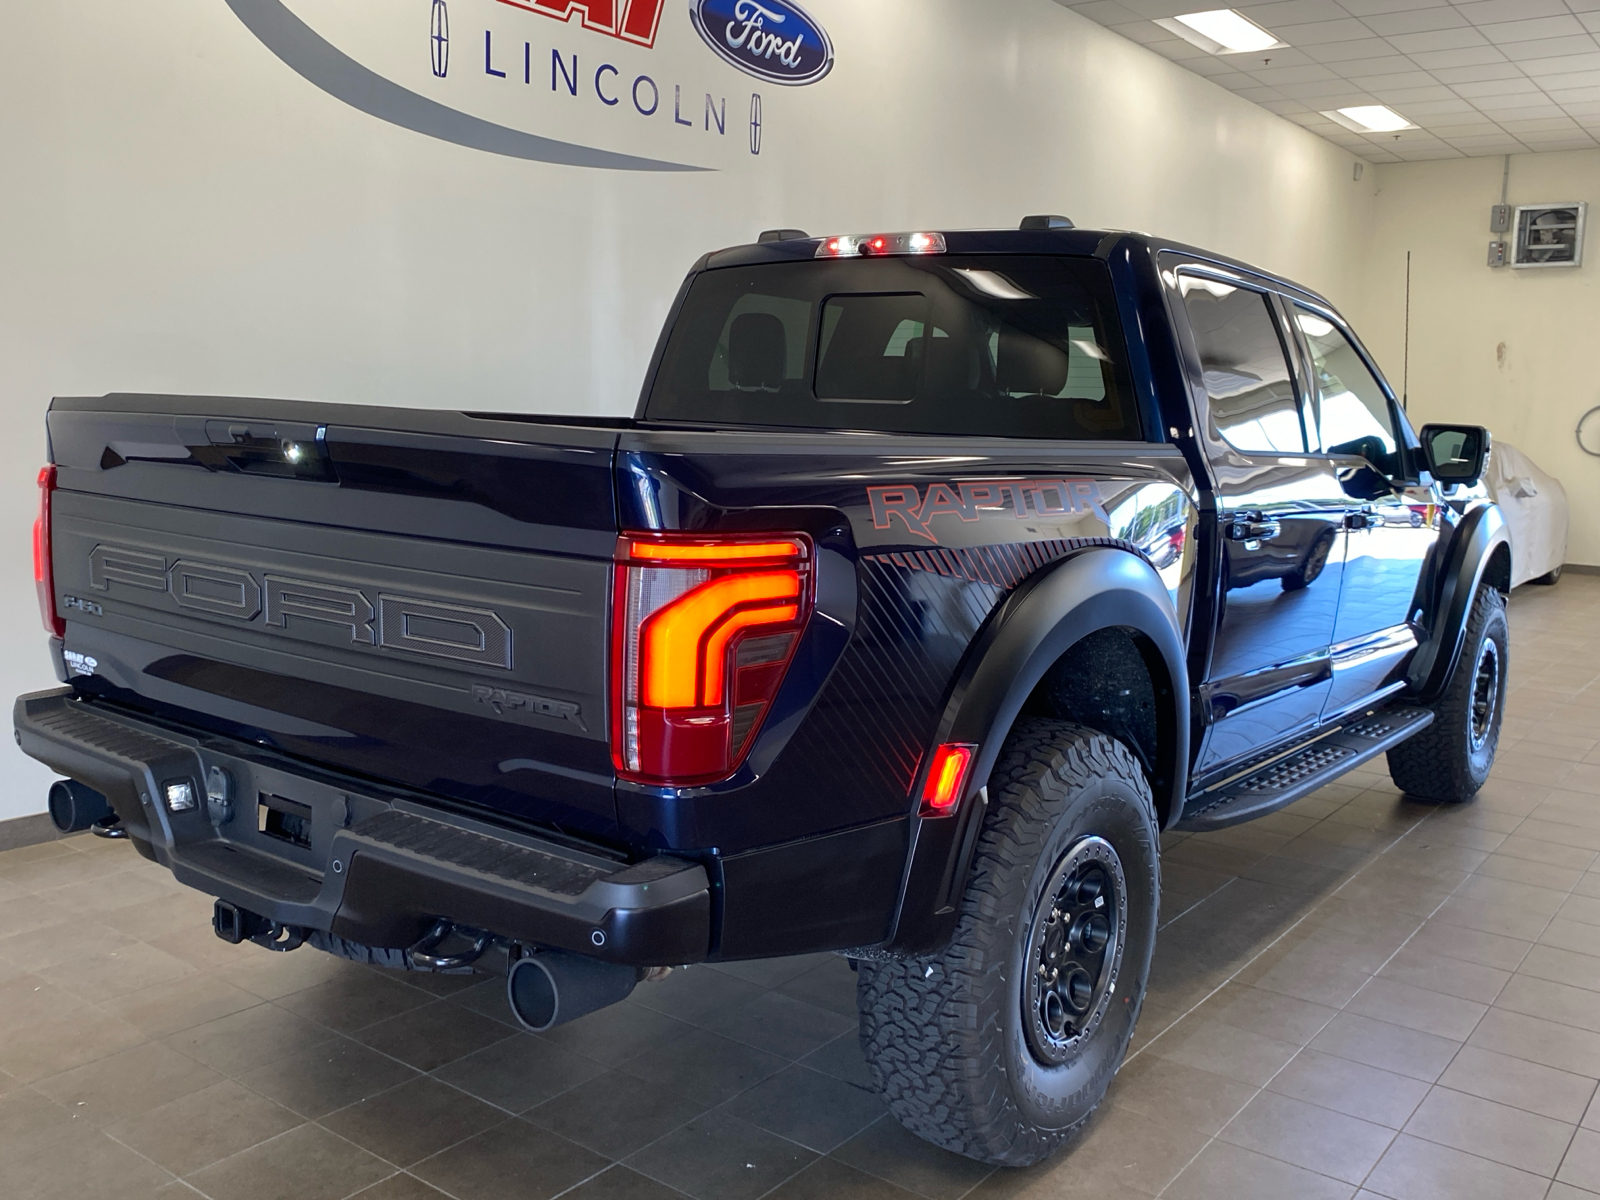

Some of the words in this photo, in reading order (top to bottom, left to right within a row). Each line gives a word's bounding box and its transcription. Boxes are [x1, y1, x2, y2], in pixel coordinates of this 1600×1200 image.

[726, 0, 802, 69] Ford
[485, 30, 727, 136] LINCOLN
[866, 480, 1115, 544] RAPTOR
[88, 543, 514, 671] FORD
[471, 684, 589, 733] RAPTOR
